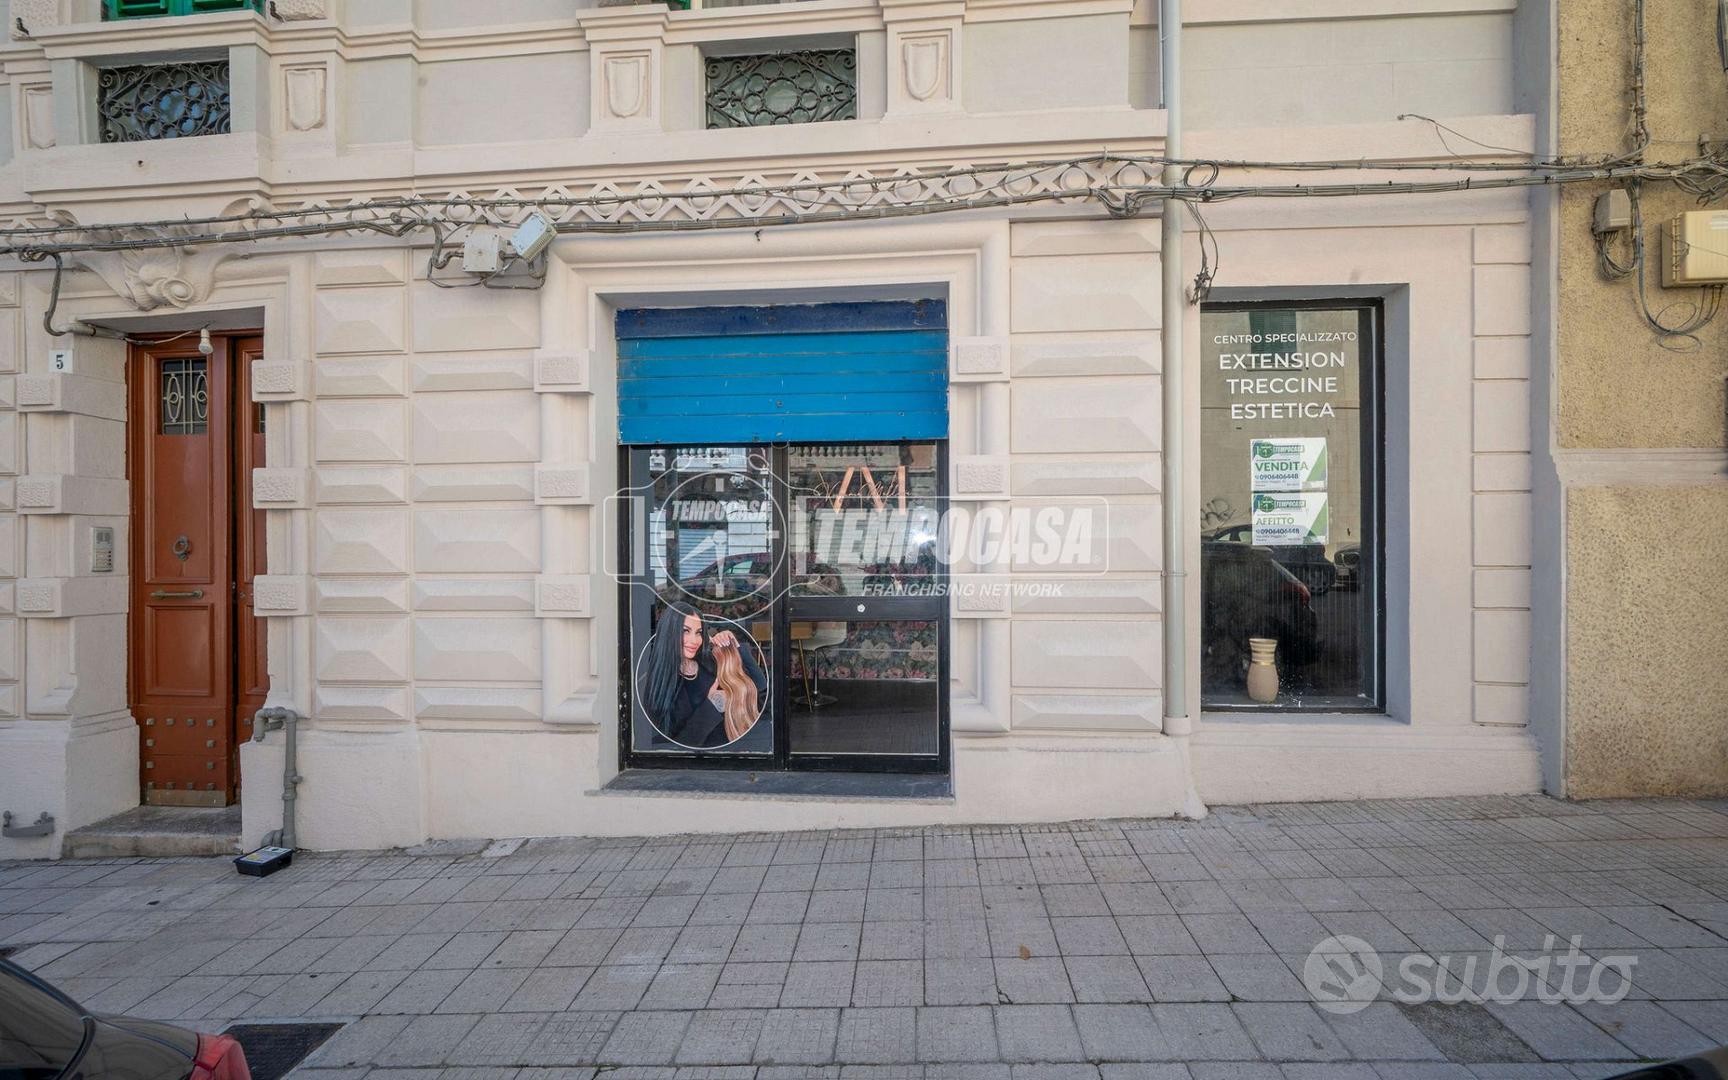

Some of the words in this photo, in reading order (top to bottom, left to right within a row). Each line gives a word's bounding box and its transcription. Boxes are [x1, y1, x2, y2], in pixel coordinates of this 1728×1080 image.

[1214, 334, 1262, 344] CENTRO
[1265, 331, 1357, 343] SPECIALIZZATO
[56, 354, 64, 369] 5
[1219, 351, 1345, 370] EXTENSION
[1226, 376, 1338, 394] TRECCINE
[1231, 402, 1335, 420] ESTETICA
[1255, 461, 1309, 472] VENDITA
[1256, 517, 1295, 526] AFFITTO
